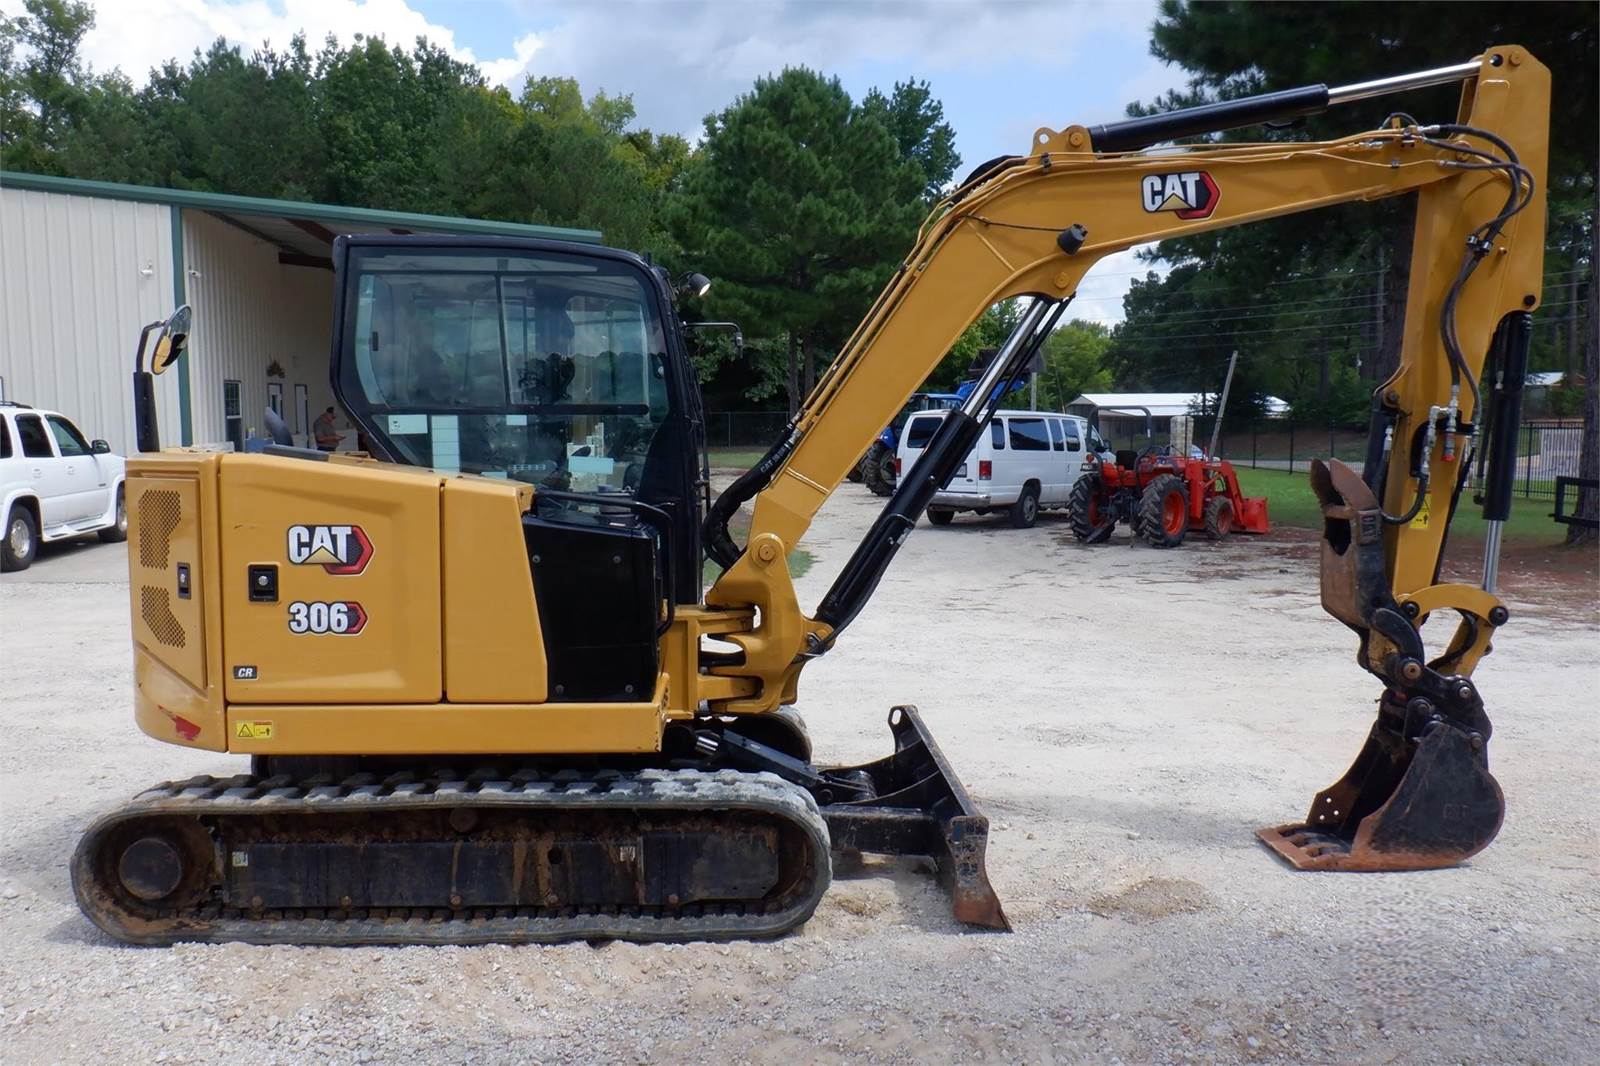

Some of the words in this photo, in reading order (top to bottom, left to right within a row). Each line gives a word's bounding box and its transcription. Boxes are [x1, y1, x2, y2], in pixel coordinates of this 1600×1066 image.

[1143, 172, 1200, 212] CAT
[288, 525, 352, 564] CAT
[289, 602, 349, 633] 306
[238, 667, 254, 678] CR
